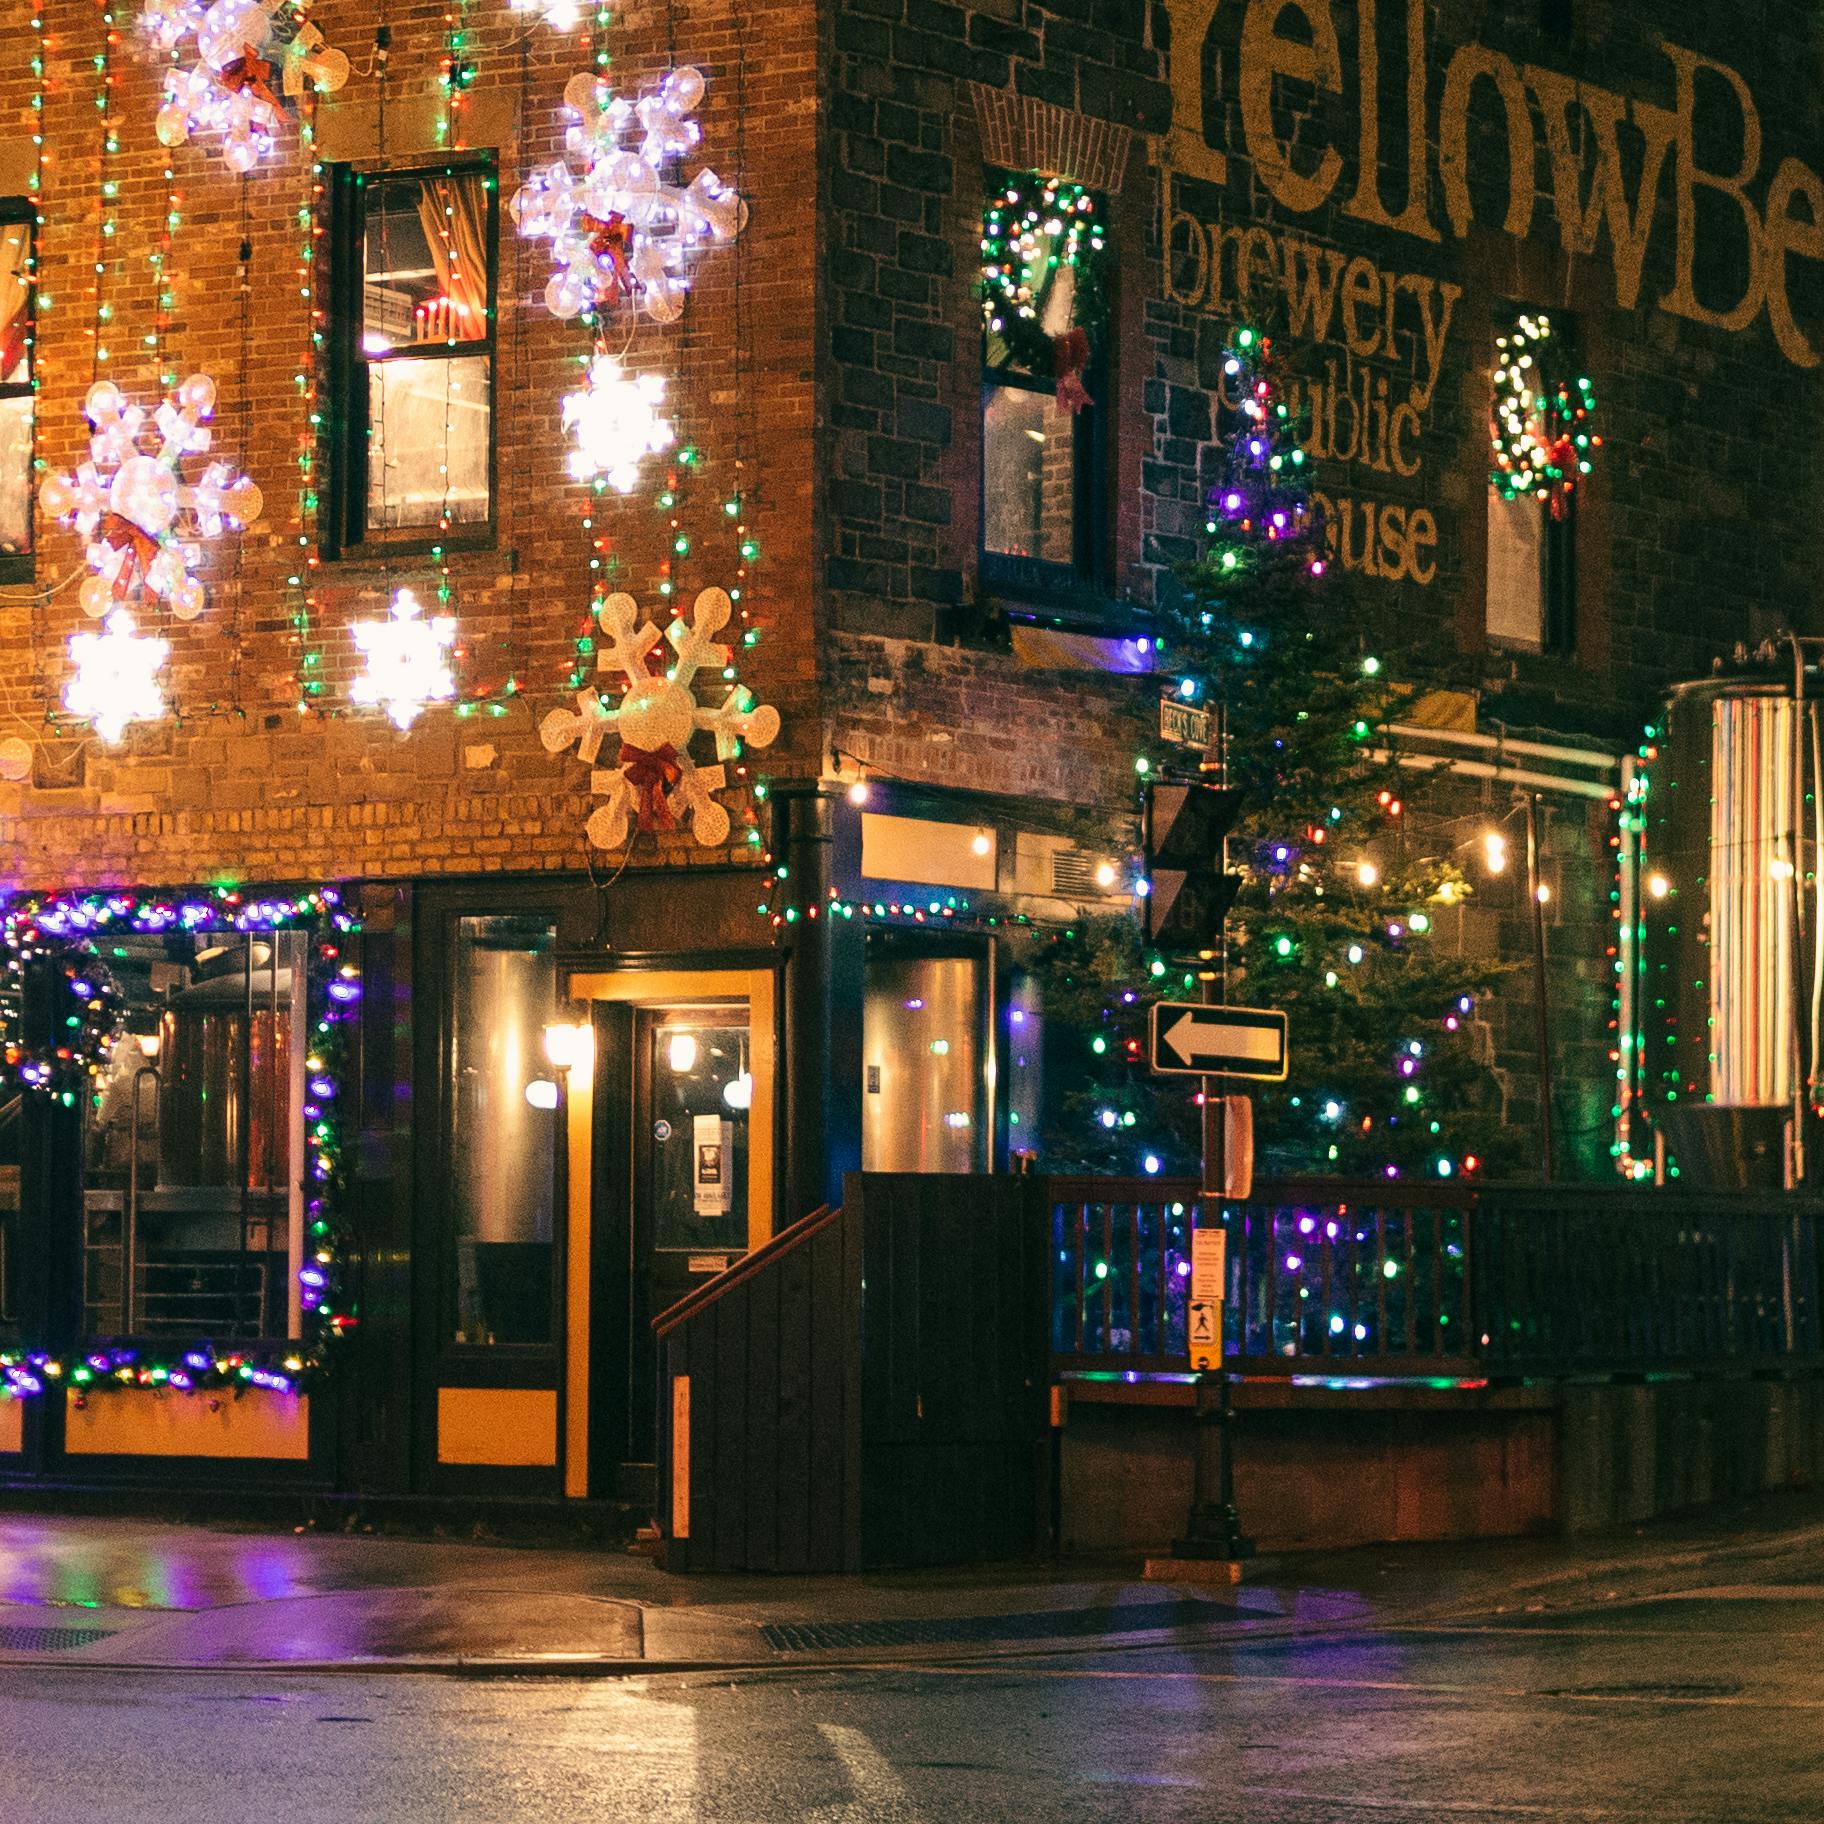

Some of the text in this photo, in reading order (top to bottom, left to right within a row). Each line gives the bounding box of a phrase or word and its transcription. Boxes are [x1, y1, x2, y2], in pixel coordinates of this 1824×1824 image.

[1162, 170, 1464, 412] brewery
[1272, 359, 1422, 480] ublic
[1294, 490, 1439, 587] ouse
